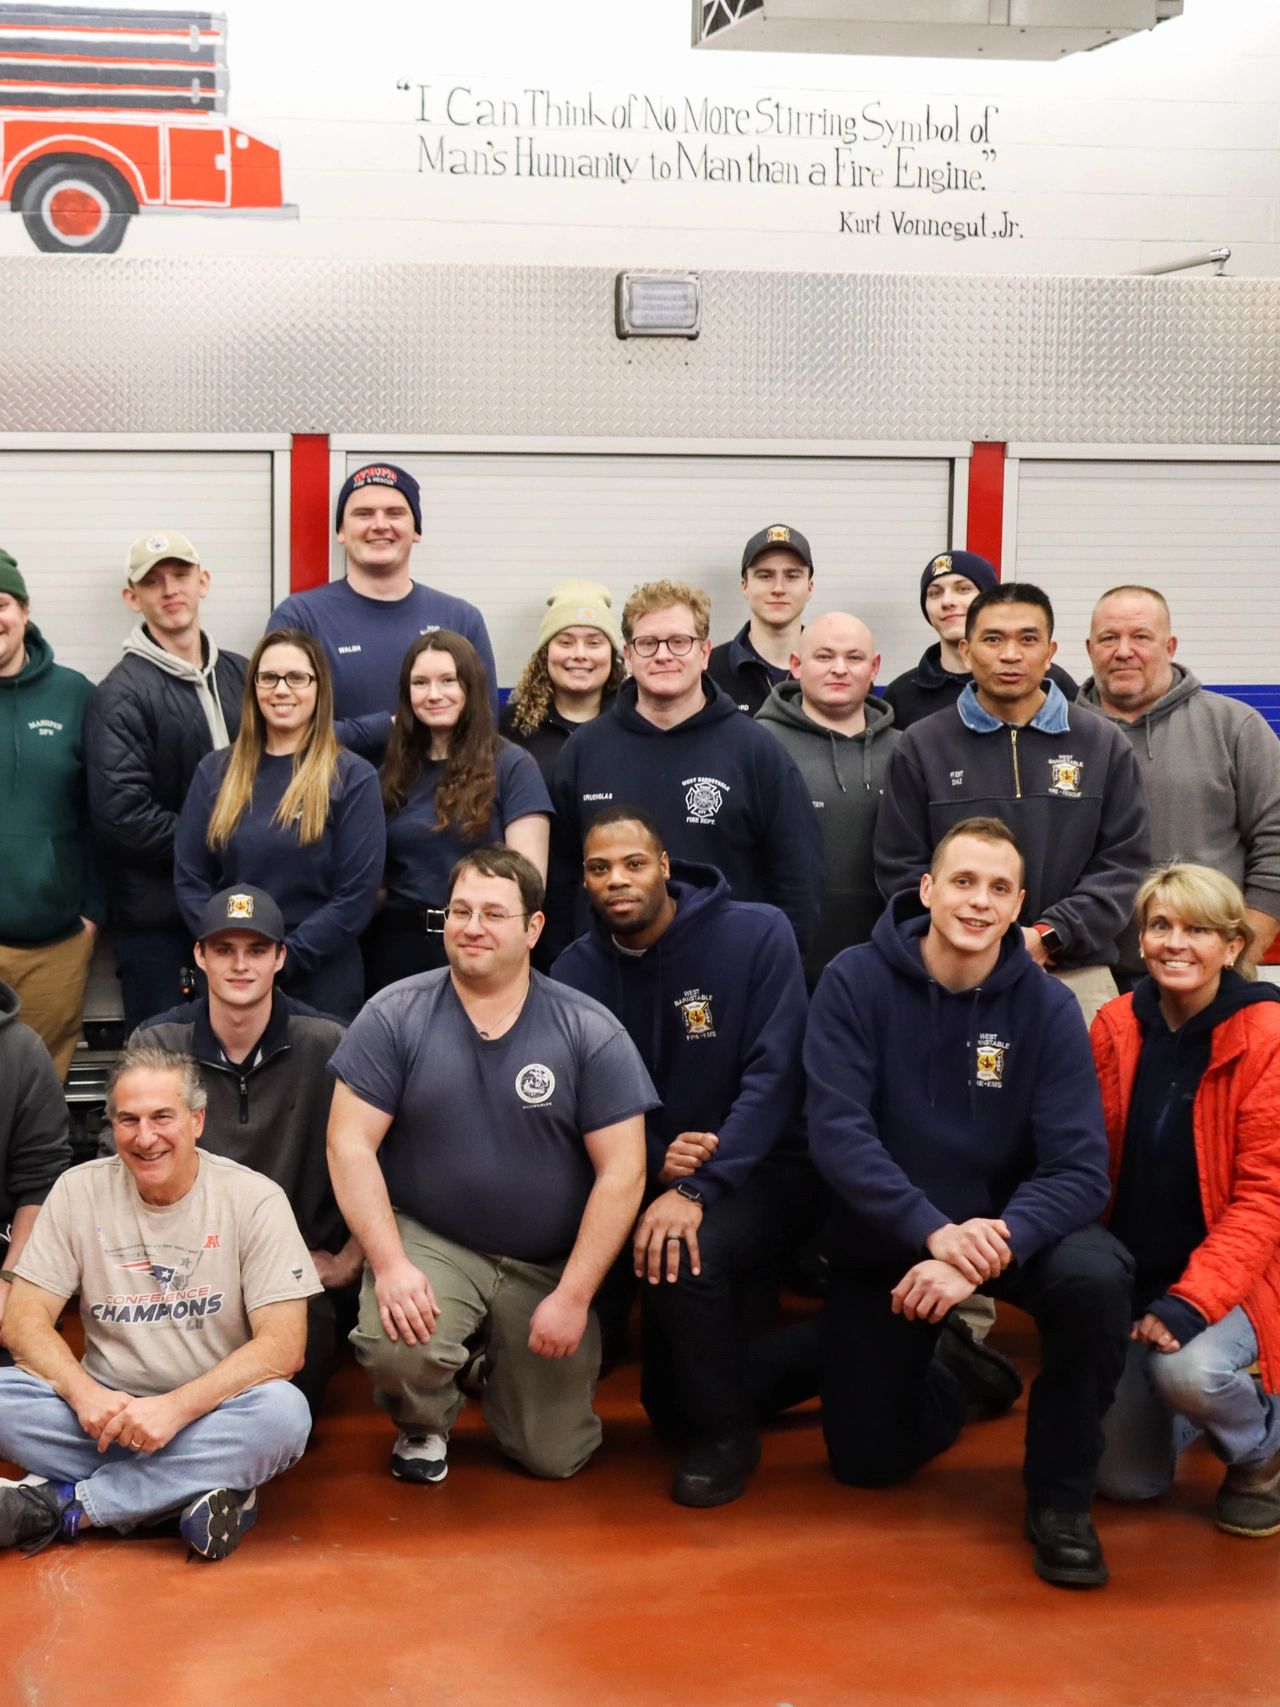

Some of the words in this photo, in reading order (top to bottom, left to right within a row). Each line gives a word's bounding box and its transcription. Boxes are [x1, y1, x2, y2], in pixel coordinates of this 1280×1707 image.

[446, 86, 519, 126] Can
[524, 89, 607, 126] Think
[611, 94, 637, 129] of
[642, 94, 676, 131] No
[684, 96, 750, 136] More
[756, 97, 857, 144] Stirring
[862, 101, 960, 148] Symbol
[970, 104, 999, 143] of
[417, 135, 507, 175] Man's
[515, 136, 639, 184] Humanity
[650, 152, 671, 180] to
[676, 140, 741, 183] Man
[747, 144, 799, 184] than
[809, 161, 826, 186] a
[835, 147, 884, 188] Fire
[839, 210, 881, 234] Kurt
[104, 1286, 210, 1305] CONFEENCE
